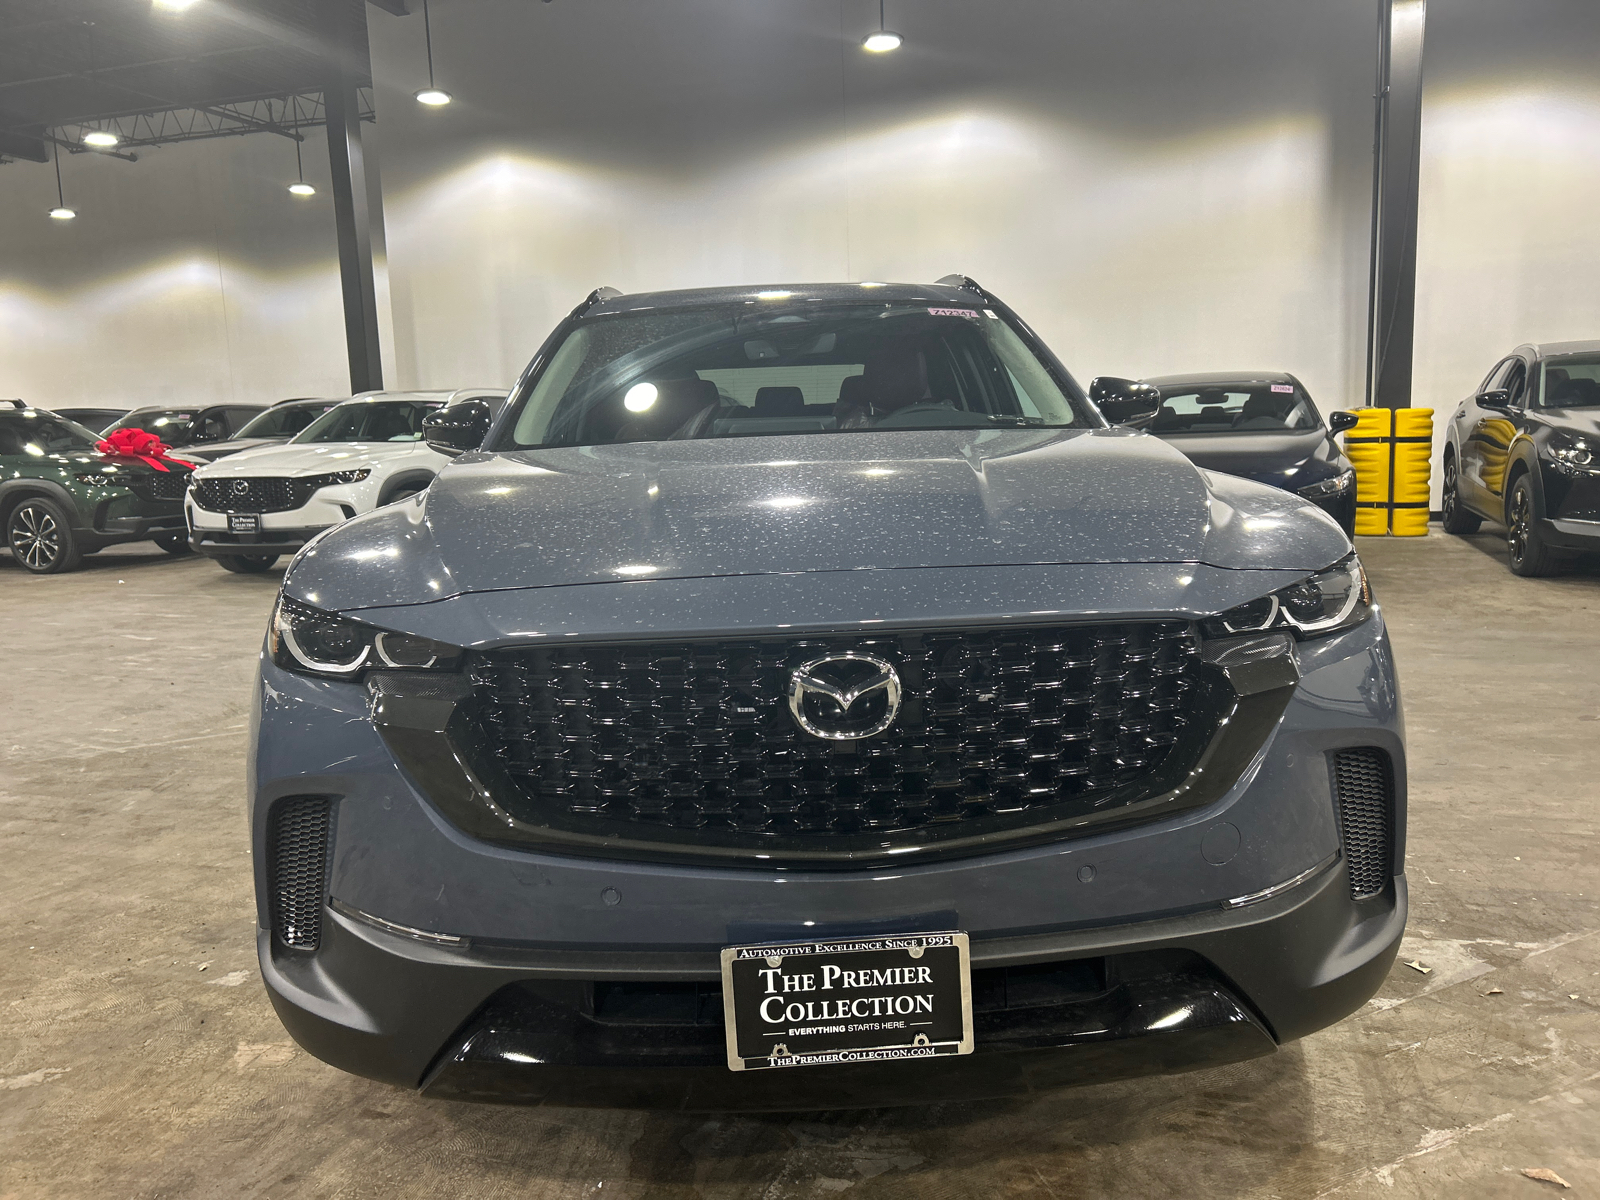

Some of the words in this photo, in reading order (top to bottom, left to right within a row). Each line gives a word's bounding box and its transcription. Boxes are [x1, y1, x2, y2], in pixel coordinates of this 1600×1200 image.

[739, 945, 812, 959] AUTOMOTIVE
[815, 941, 882, 953] EXCELLENCE
[885, 938, 918, 949] SINCE
[921, 936, 951, 947] 1995
[758, 968, 816, 993] THE
[821, 965, 933, 990] PREMIER
[760, 994, 934, 1023] COLLECTION
[788, 1025, 846, 1036] EVERYTHING
[847, 1022, 880, 1032] STARTS
[882, 1021, 907, 1031] HERE.
